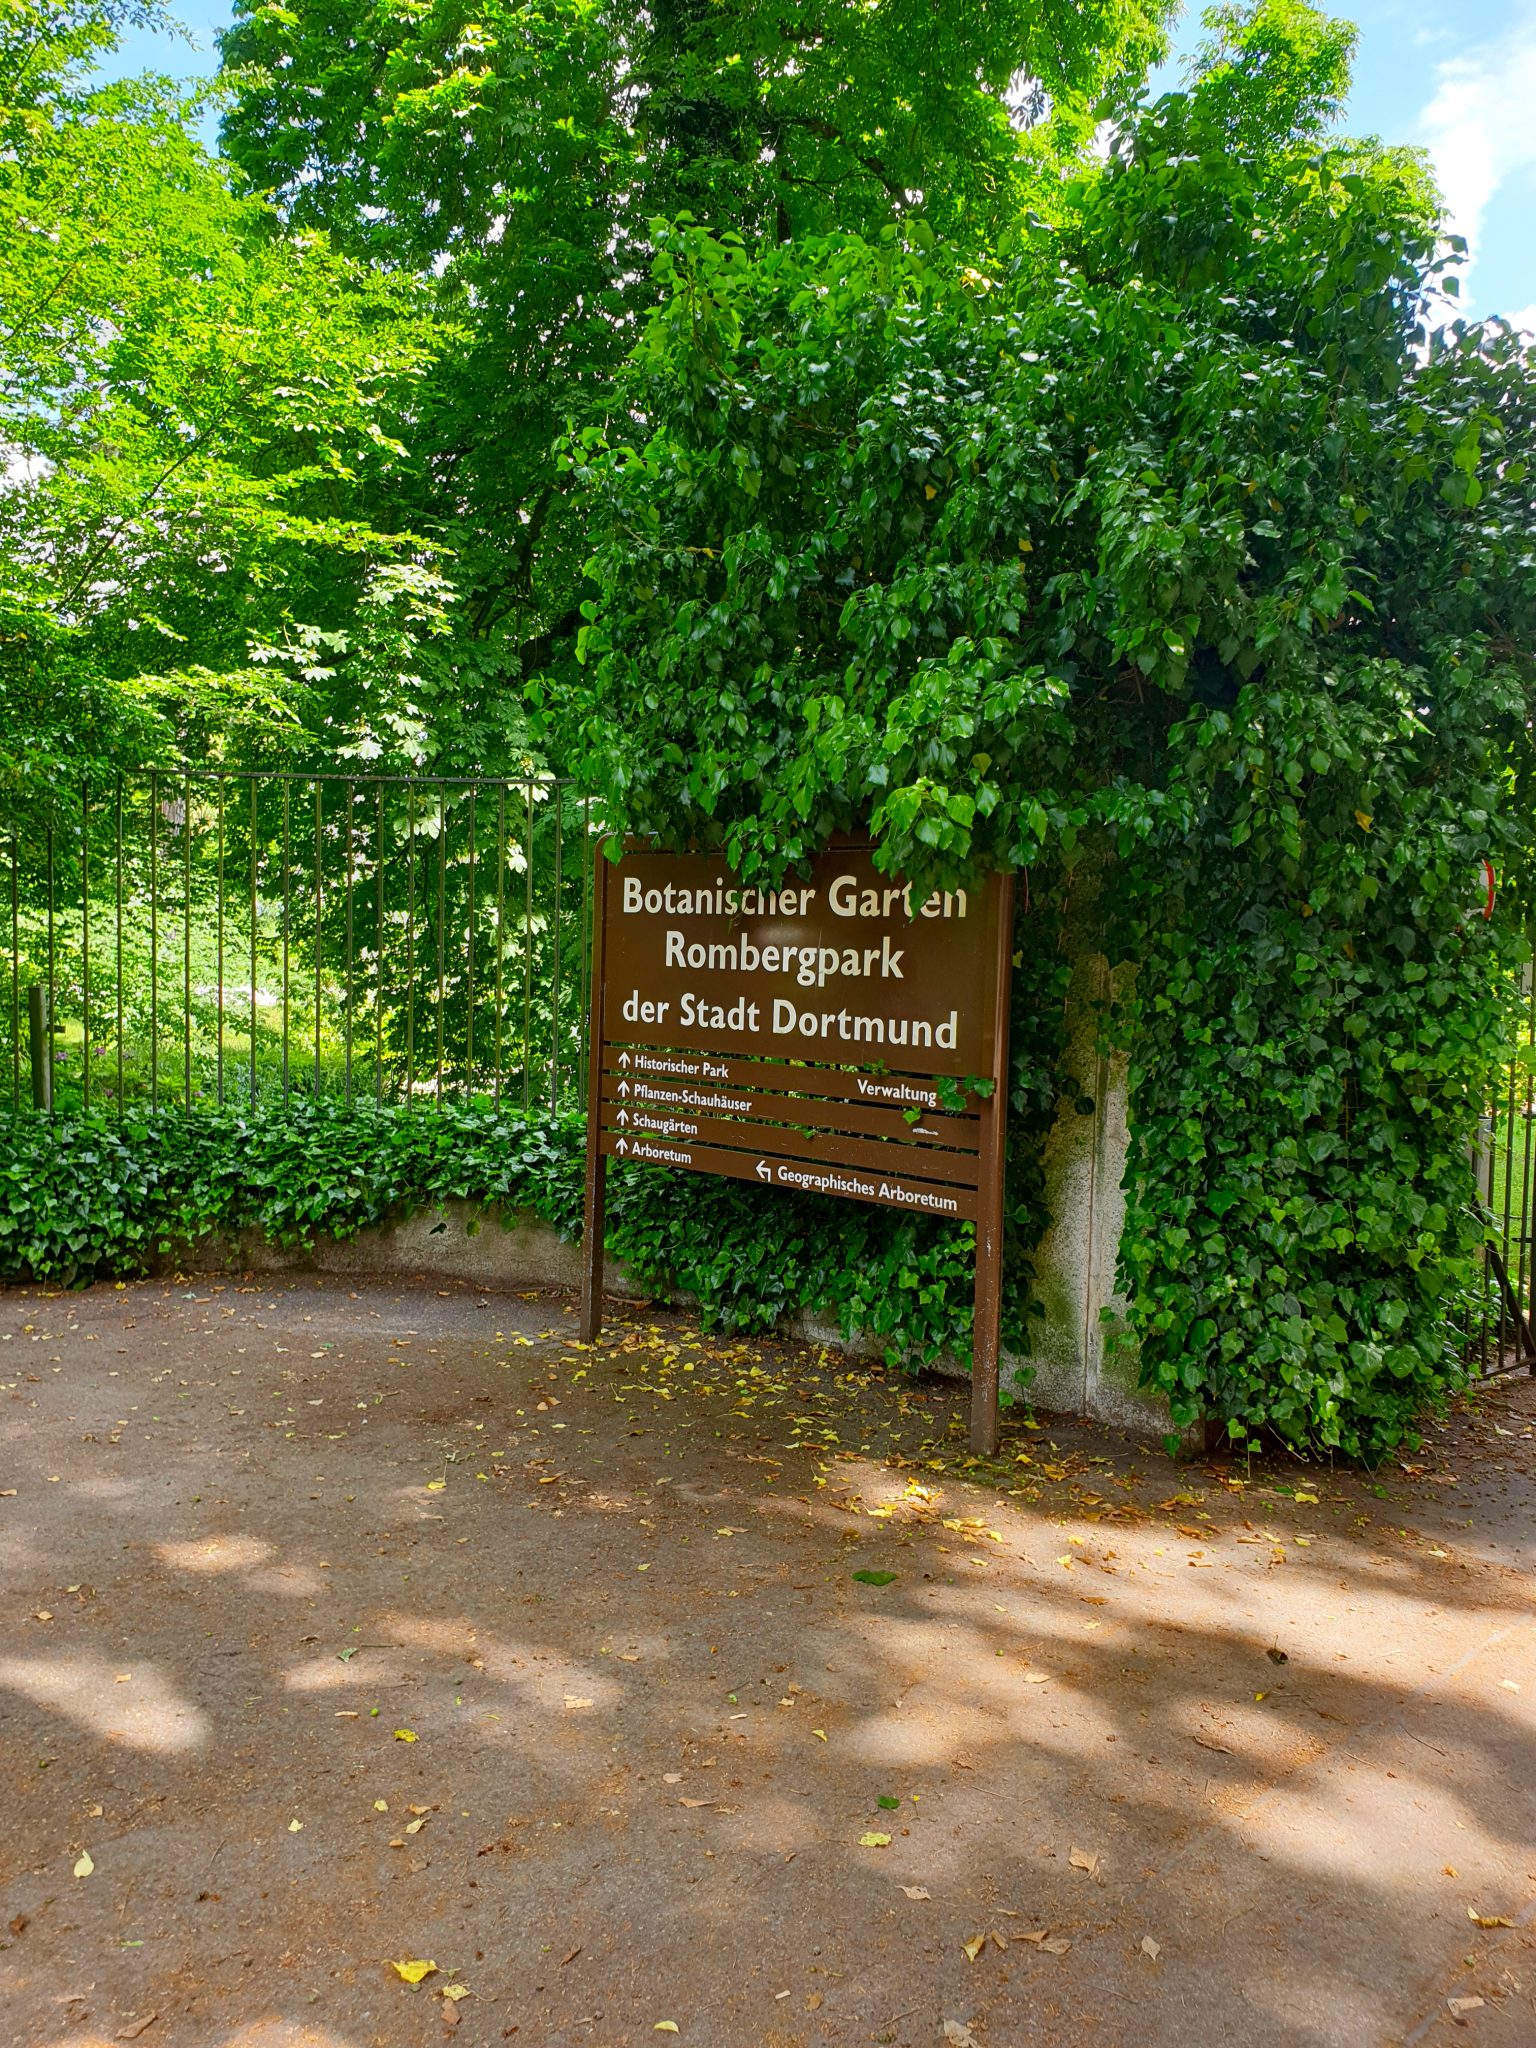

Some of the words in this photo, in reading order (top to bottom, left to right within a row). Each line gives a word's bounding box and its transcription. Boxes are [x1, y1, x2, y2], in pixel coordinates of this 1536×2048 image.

[623, 877, 816, 916] Botanischer
[828, 875, 967, 918] Garten
[665, 930, 905, 987] Rombergpark
[622, 990, 669, 1024] der
[680, 993, 760, 1032] Stadt
[772, 999, 958, 1049] Dortmund
[634, 1055, 699, 1075] Historischer
[702, 1062, 729, 1078] Park
[634, 1084, 752, 1112] Pflanzen-Schauhäuser
[857, 1079, 937, 1107] Verwaltung
[633, 1113, 698, 1135] Schaugärten
[632, 1142, 692, 1164] Arboretum
[777, 1166, 875, 1196] Geographisches
[878, 1183, 958, 1211] Arboretum
